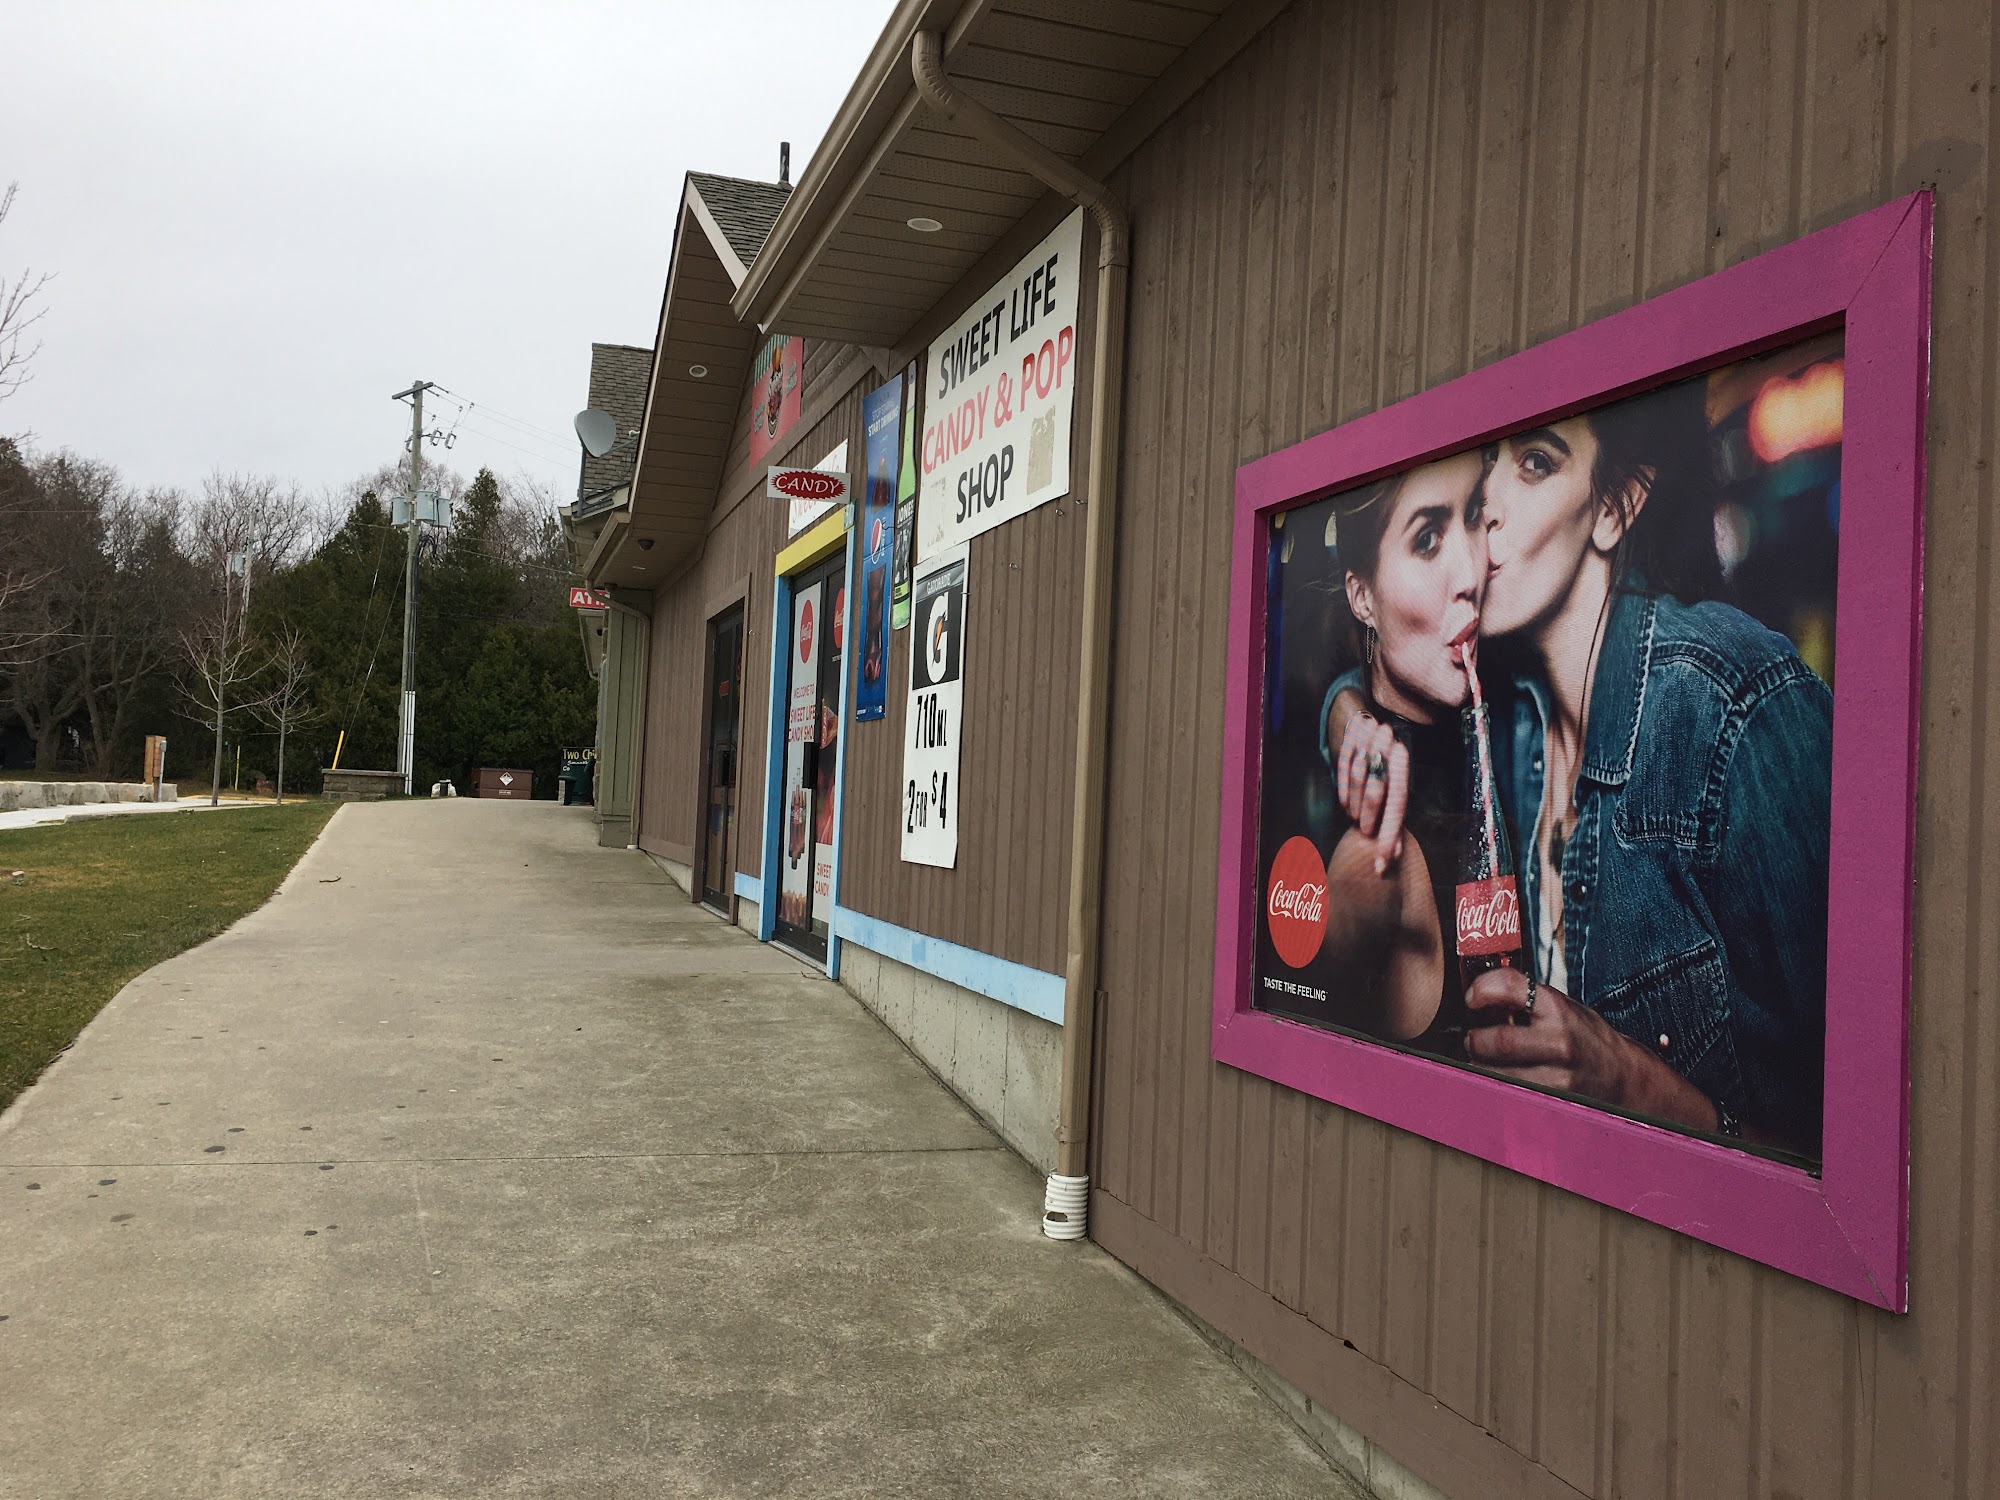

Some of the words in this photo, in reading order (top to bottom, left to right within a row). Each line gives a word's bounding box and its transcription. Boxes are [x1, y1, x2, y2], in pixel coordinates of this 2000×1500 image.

[938, 299, 1005, 400] SWEET
[1010, 252, 1058, 344] LIFE
[923, 385, 990, 475] CANDY
[993, 372, 1013, 429] &
[1020, 325, 1073, 412] POP
[868, 419, 880, 437] START
[775, 476, 840, 494] CANDY
[956, 444, 1014, 524] SHOP
[897, 499, 914, 524] JONES
[927, 572, 951, 595] GATORADE
[926, 591, 949, 683] G
[790, 705, 805, 724] SWEET
[804, 725, 815, 741] SHO
[562, 749, 579, 760] Two
[582, 749, 597, 760] Chi
[1269, 879, 1326, 922] Coca-Cola
[1457, 889, 1519, 942] Coca-Cola
[1263, 977, 1283, 992] TASTE
[1284, 981, 1297, 995] THE
[1297, 984, 1327, 1002] FEELING
